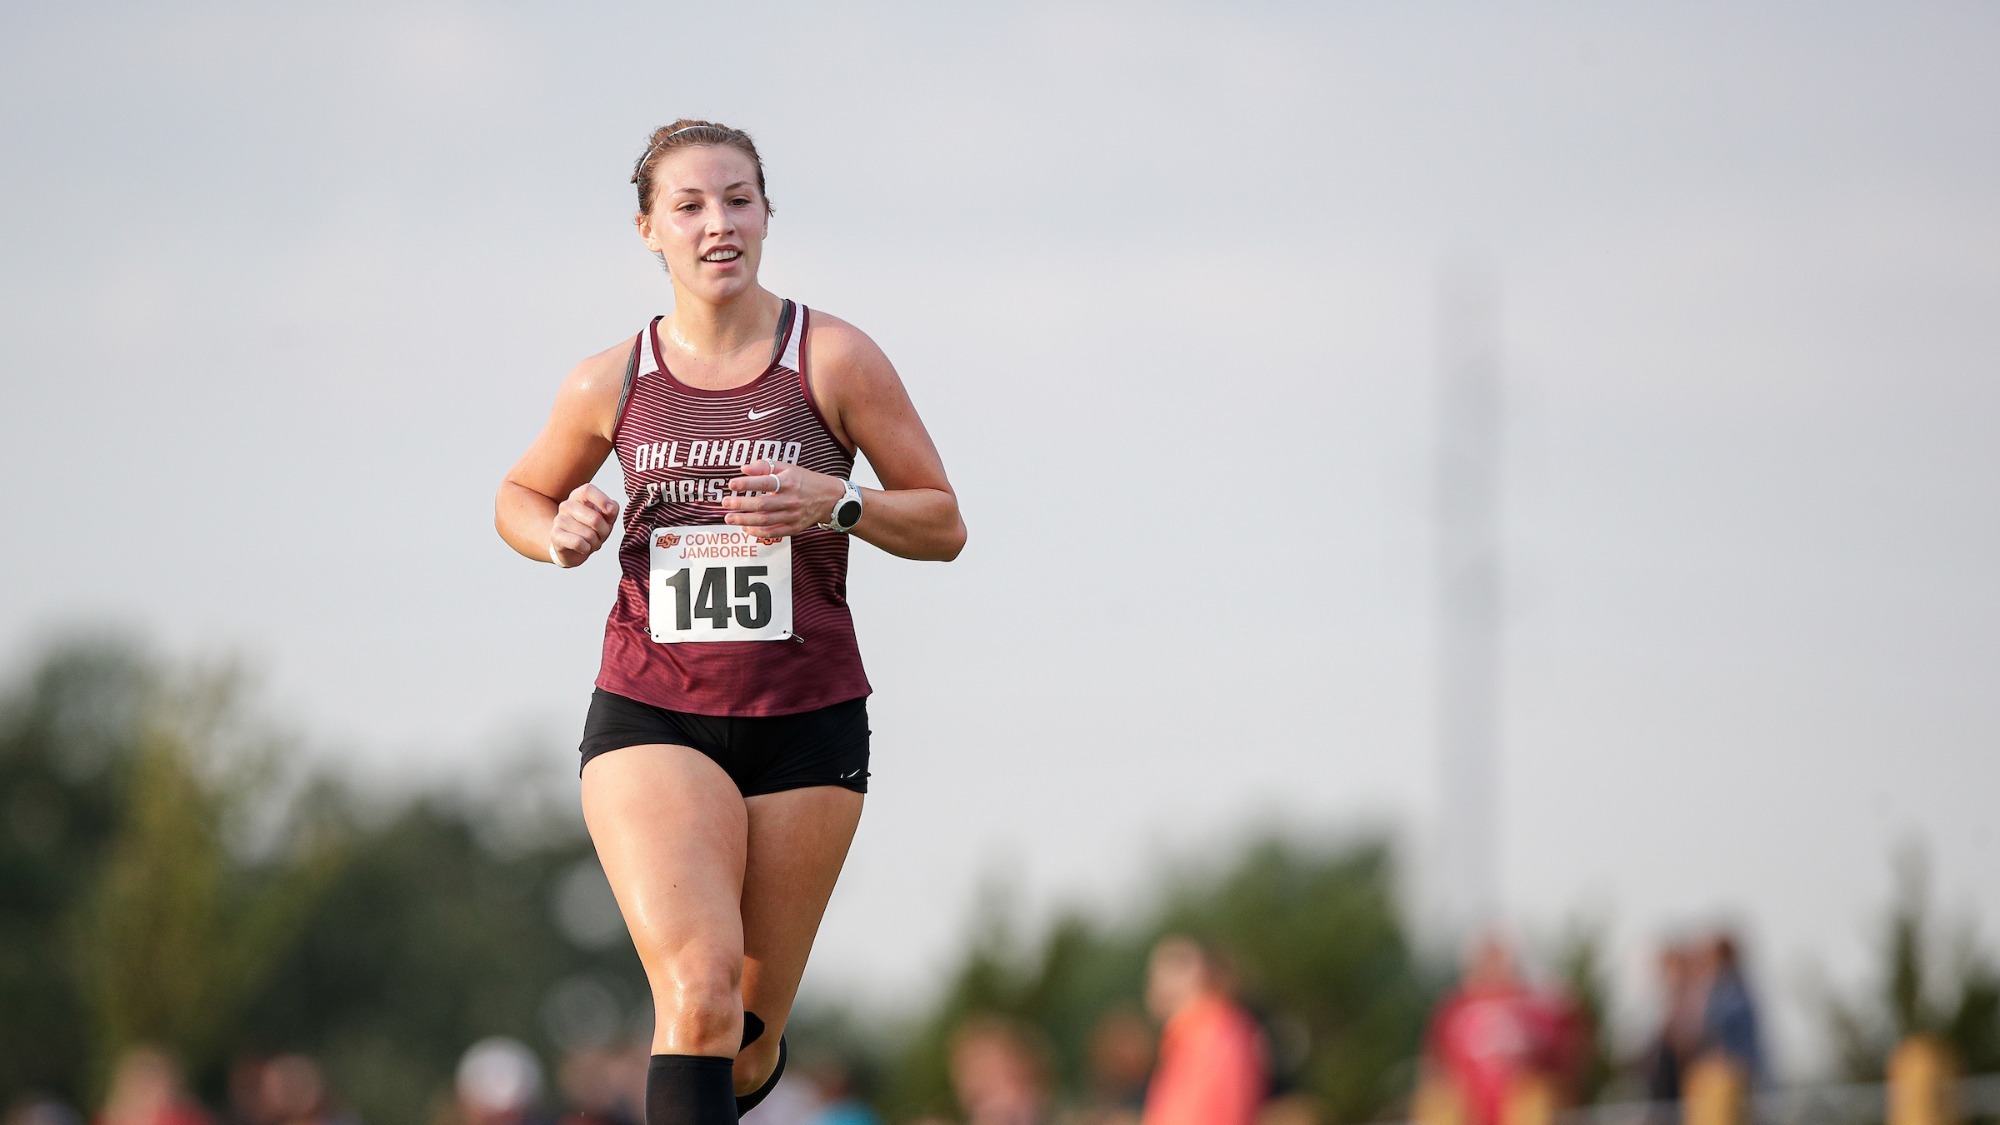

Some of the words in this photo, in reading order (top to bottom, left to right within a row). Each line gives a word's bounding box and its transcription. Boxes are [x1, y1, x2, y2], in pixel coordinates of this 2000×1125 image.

[635, 439, 802, 473] OKLAHOMA
[646, 478, 771, 508] CHRIS
[679, 546, 757, 559] JAMBOREE
[685, 533, 750, 546] COWBOY
[666, 565, 772, 631] 145
